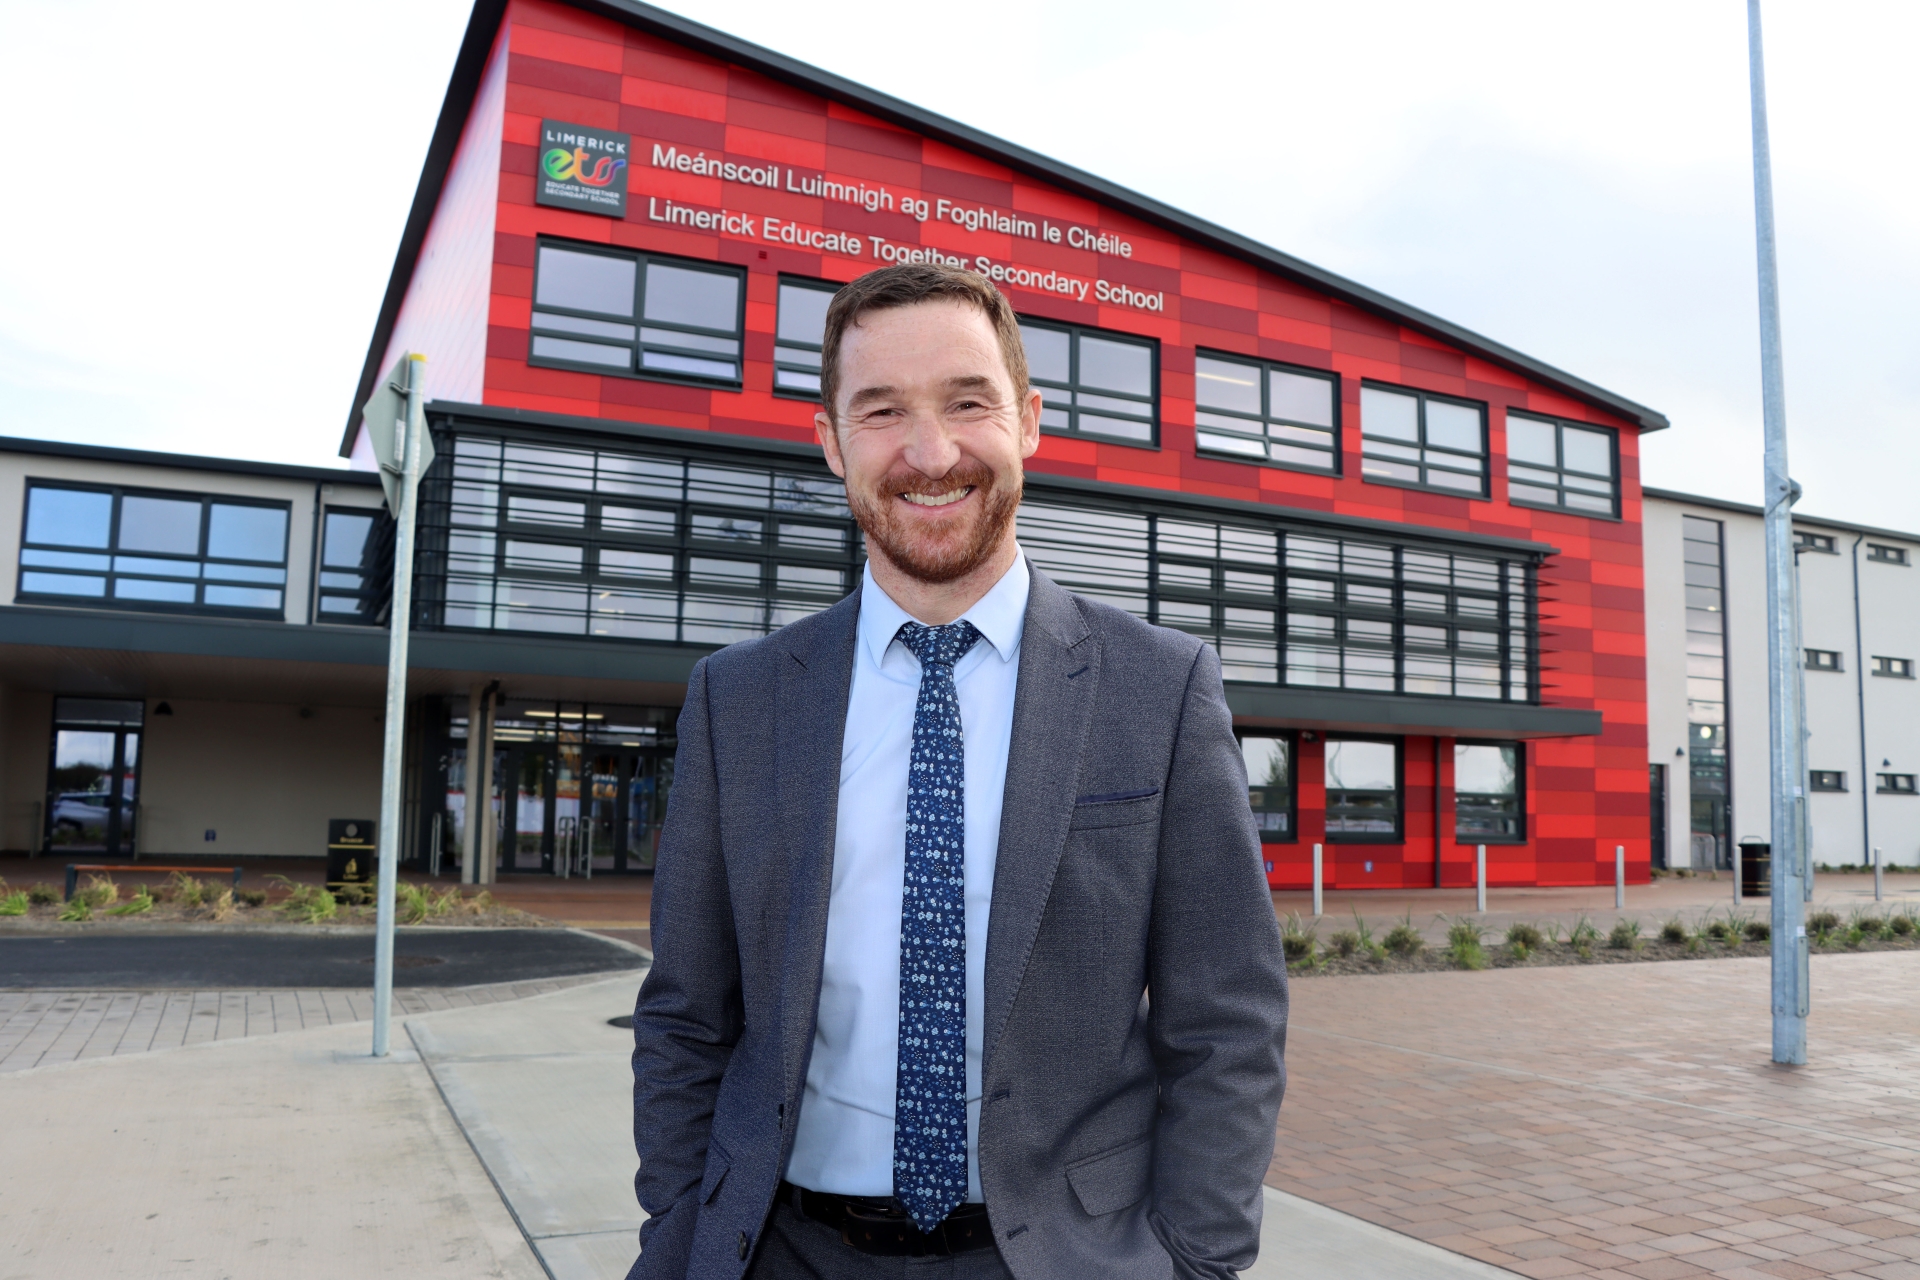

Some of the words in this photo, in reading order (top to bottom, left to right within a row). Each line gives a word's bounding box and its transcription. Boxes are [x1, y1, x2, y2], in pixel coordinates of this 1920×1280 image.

[546, 130, 626, 154] LIMERICK
[545, 180, 580, 192] EDUCATE
[581, 186, 620, 199] TOGETHER
[545, 187, 589, 200] SECONDARY
[590, 194, 620, 206] SCHOOL
[652, 143, 779, 188] Meánscoil
[786, 169, 893, 213] Luimnigh
[900, 197, 929, 222] ag
[936, 199, 1037, 239] Foghlaim
[1043, 220, 1062, 244] le
[1067, 226, 1133, 259] Chéile
[649, 197, 755, 237] Limerick
[763, 216, 862, 256] Educate
[868, 235, 969, 270] Together
[975, 256, 1090, 302] Secondary
[1094, 279, 1164, 312] School
